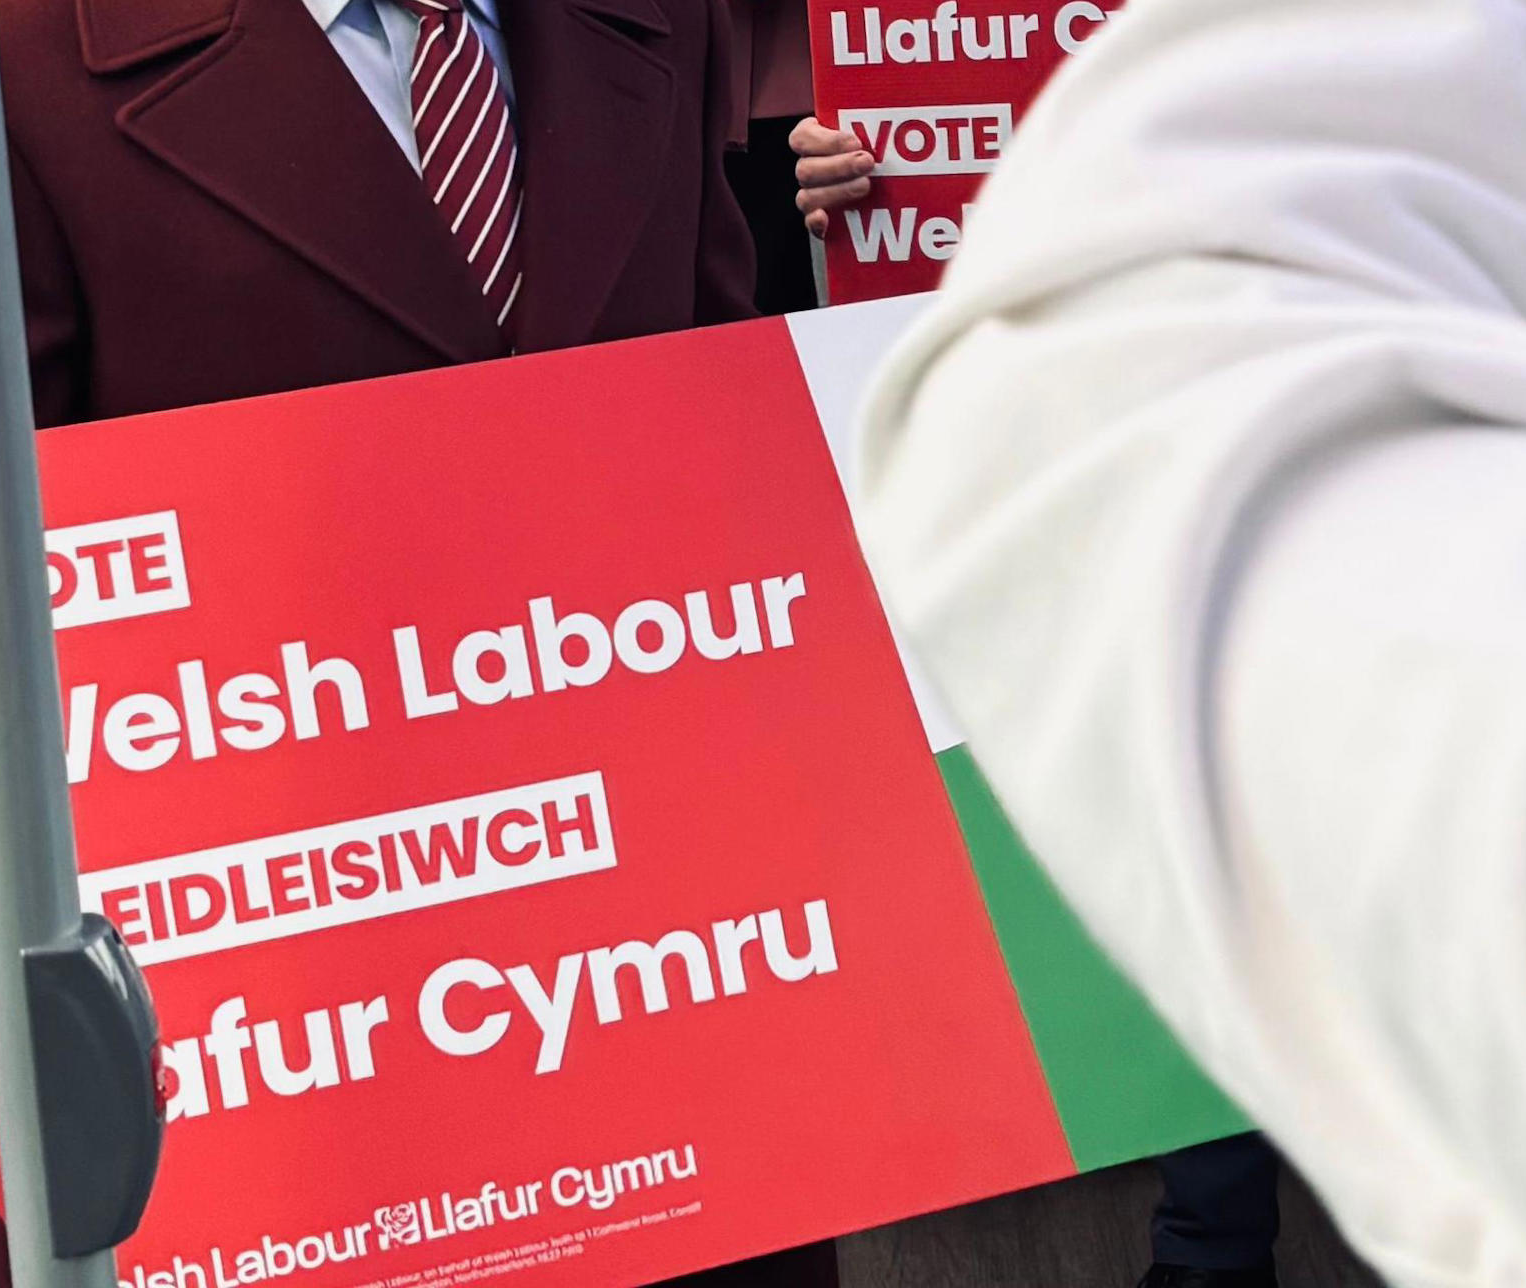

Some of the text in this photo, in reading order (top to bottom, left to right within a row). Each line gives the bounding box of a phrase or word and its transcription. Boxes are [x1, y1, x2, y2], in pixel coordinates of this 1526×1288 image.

[831, 1, 1038, 65] Llafur
[851, 117, 999, 164] VOTE
[45, 533, 172, 610] OTE
[393, 573, 805, 718] Labour
[101, 794, 598, 946] EIDLEISIWCH
[161, 900, 838, 1122] afur Cymru
[211, 1223, 371, 1288] Labour
[421, 1182, 542, 1239] Llafur
[551, 1145, 697, 1209] Cymru
